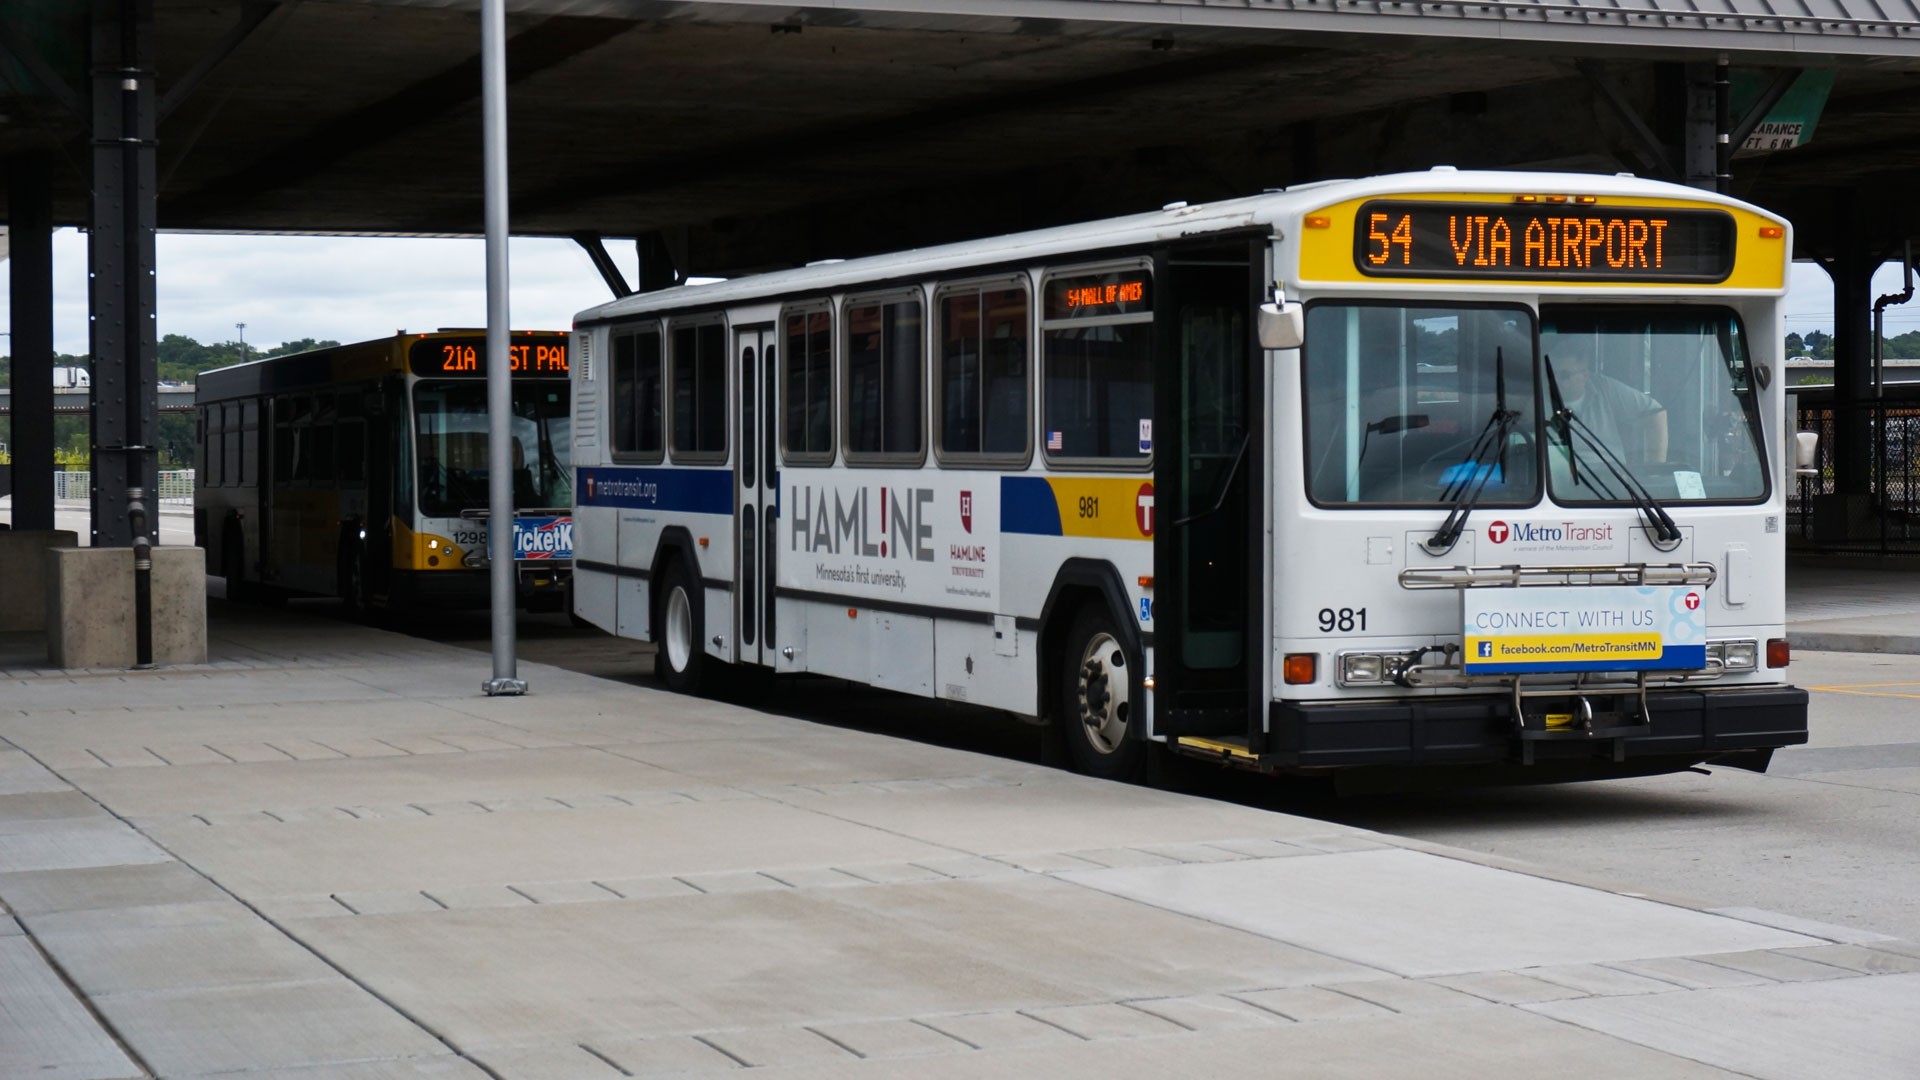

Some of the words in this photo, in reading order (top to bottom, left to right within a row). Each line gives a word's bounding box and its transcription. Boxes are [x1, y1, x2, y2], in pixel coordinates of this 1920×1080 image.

[1752, 123, 1802, 136] ARANCE
[1368, 214, 1412, 265] 54
[1449, 216, 1511, 267] VIA
[1524, 218, 1668, 268] AIRPORT
[1068, 289, 1079, 307] 54
[1081, 287, 1104, 306] MALL
[1106, 284, 1117, 304] OF
[443, 345, 477, 371] 21A
[597, 476, 657, 504] metrotransit.org
[1079, 496, 1099, 518] 981
[453, 531, 487, 545] 1298
[950, 544, 986, 563] HAMLINE
[816, 563, 854, 583] Minnesota's
[855, 566, 870, 585] first
[870, 568, 907, 593] university.
[951, 566, 985, 579] UNIVERSITY
[1318, 607, 1366, 633] 981
[1476, 610, 1570, 629] CONNECT
[1577, 610, 1624, 627] WITH
[1632, 609, 1653, 626] US
[1501, 641, 1656, 654] facebook.com/MetroTransitMN
